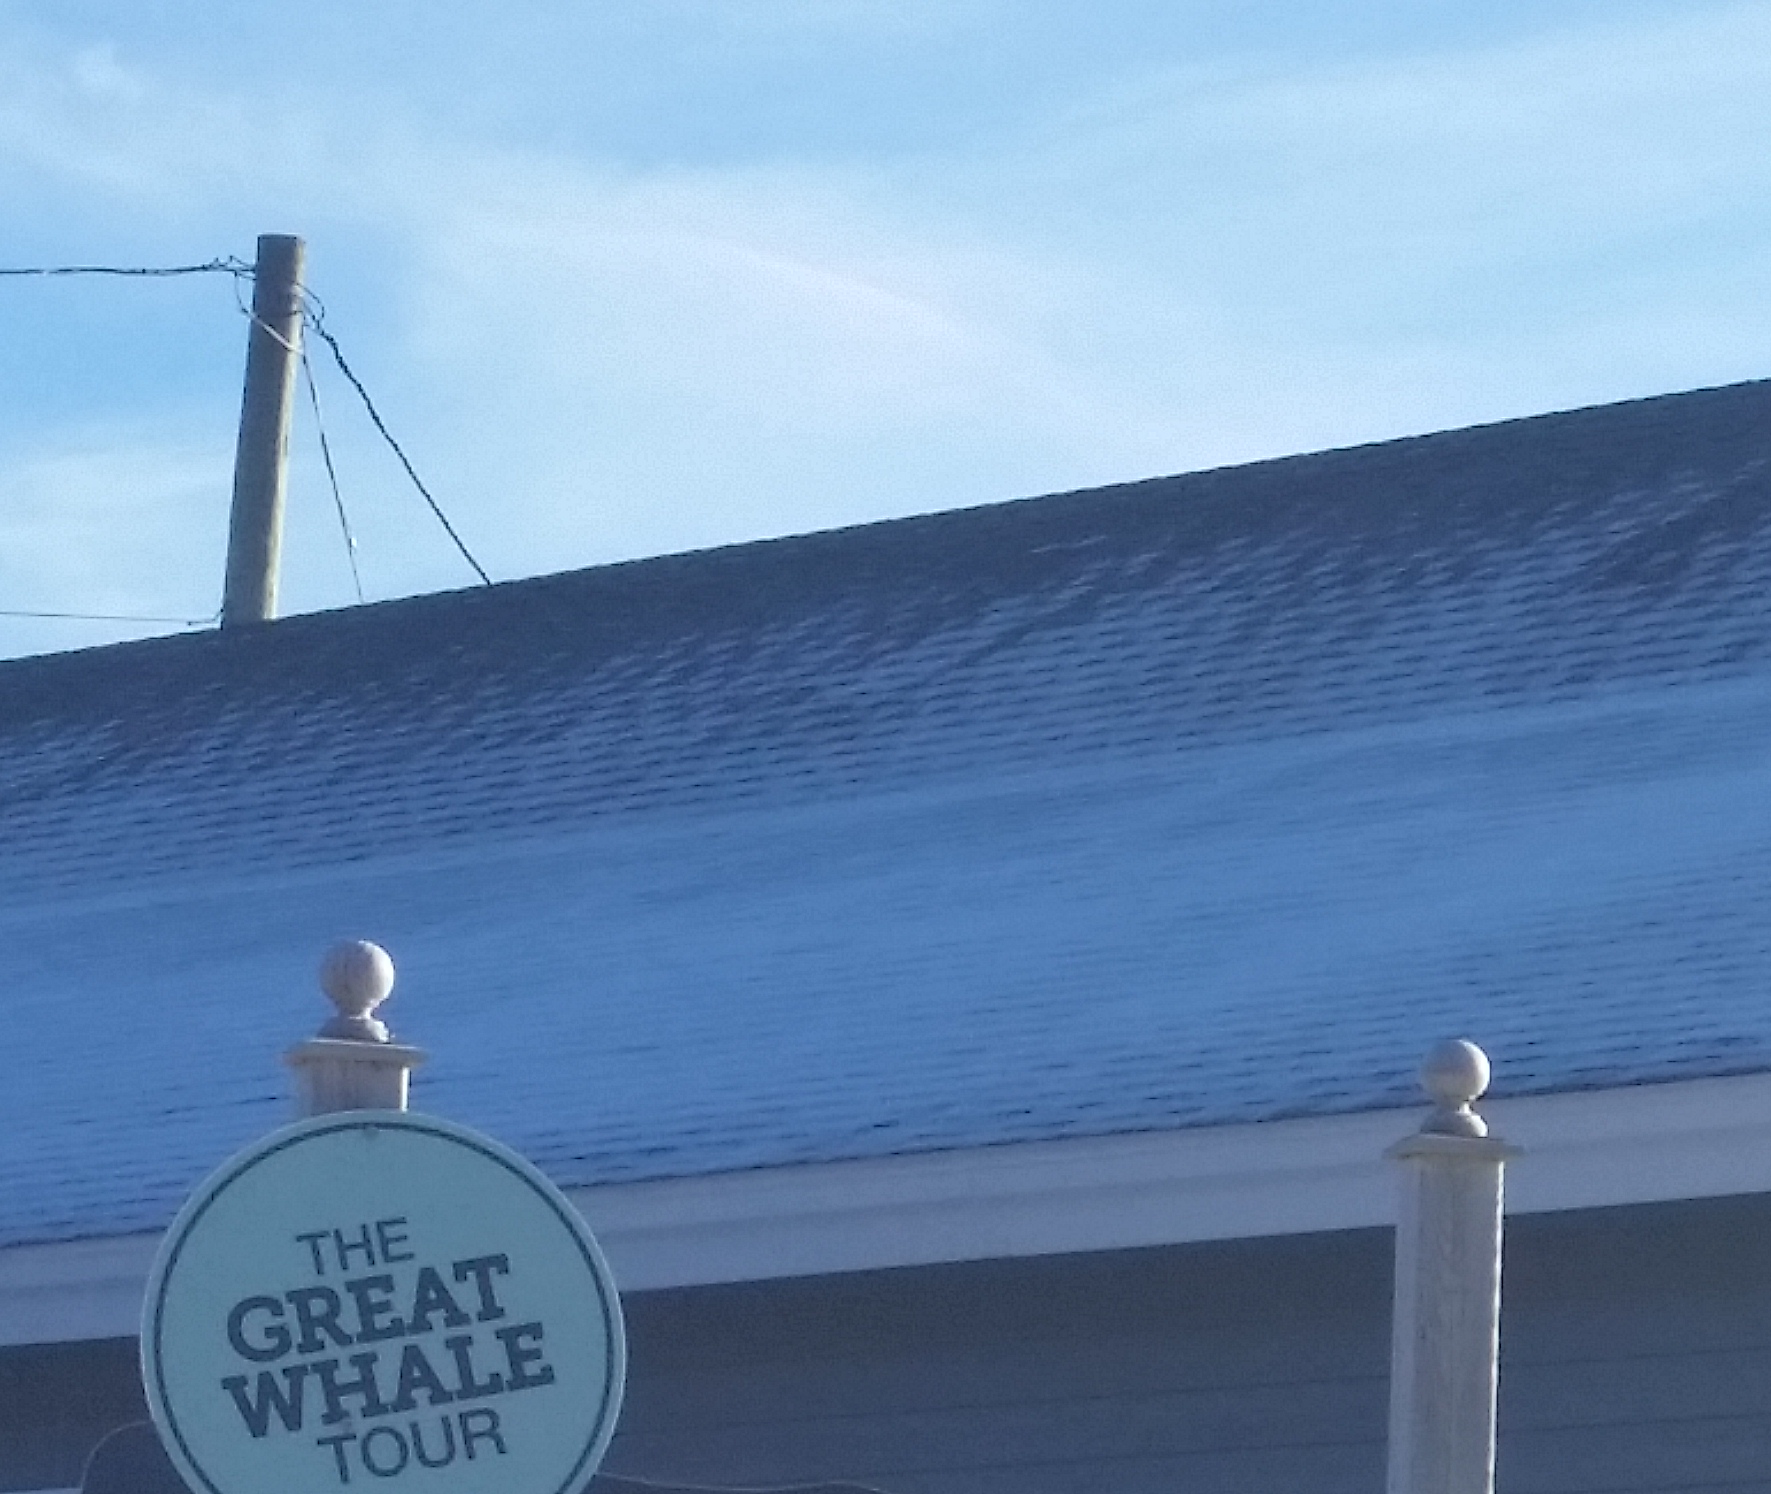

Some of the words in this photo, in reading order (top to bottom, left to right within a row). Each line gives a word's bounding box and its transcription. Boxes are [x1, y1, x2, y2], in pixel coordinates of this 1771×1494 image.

[296, 1217, 415, 1275] THE
[227, 1254, 508, 1362] GREAT
[221, 1323, 554, 1438] WHALE
[317, 1406, 506, 1485] TOUR
